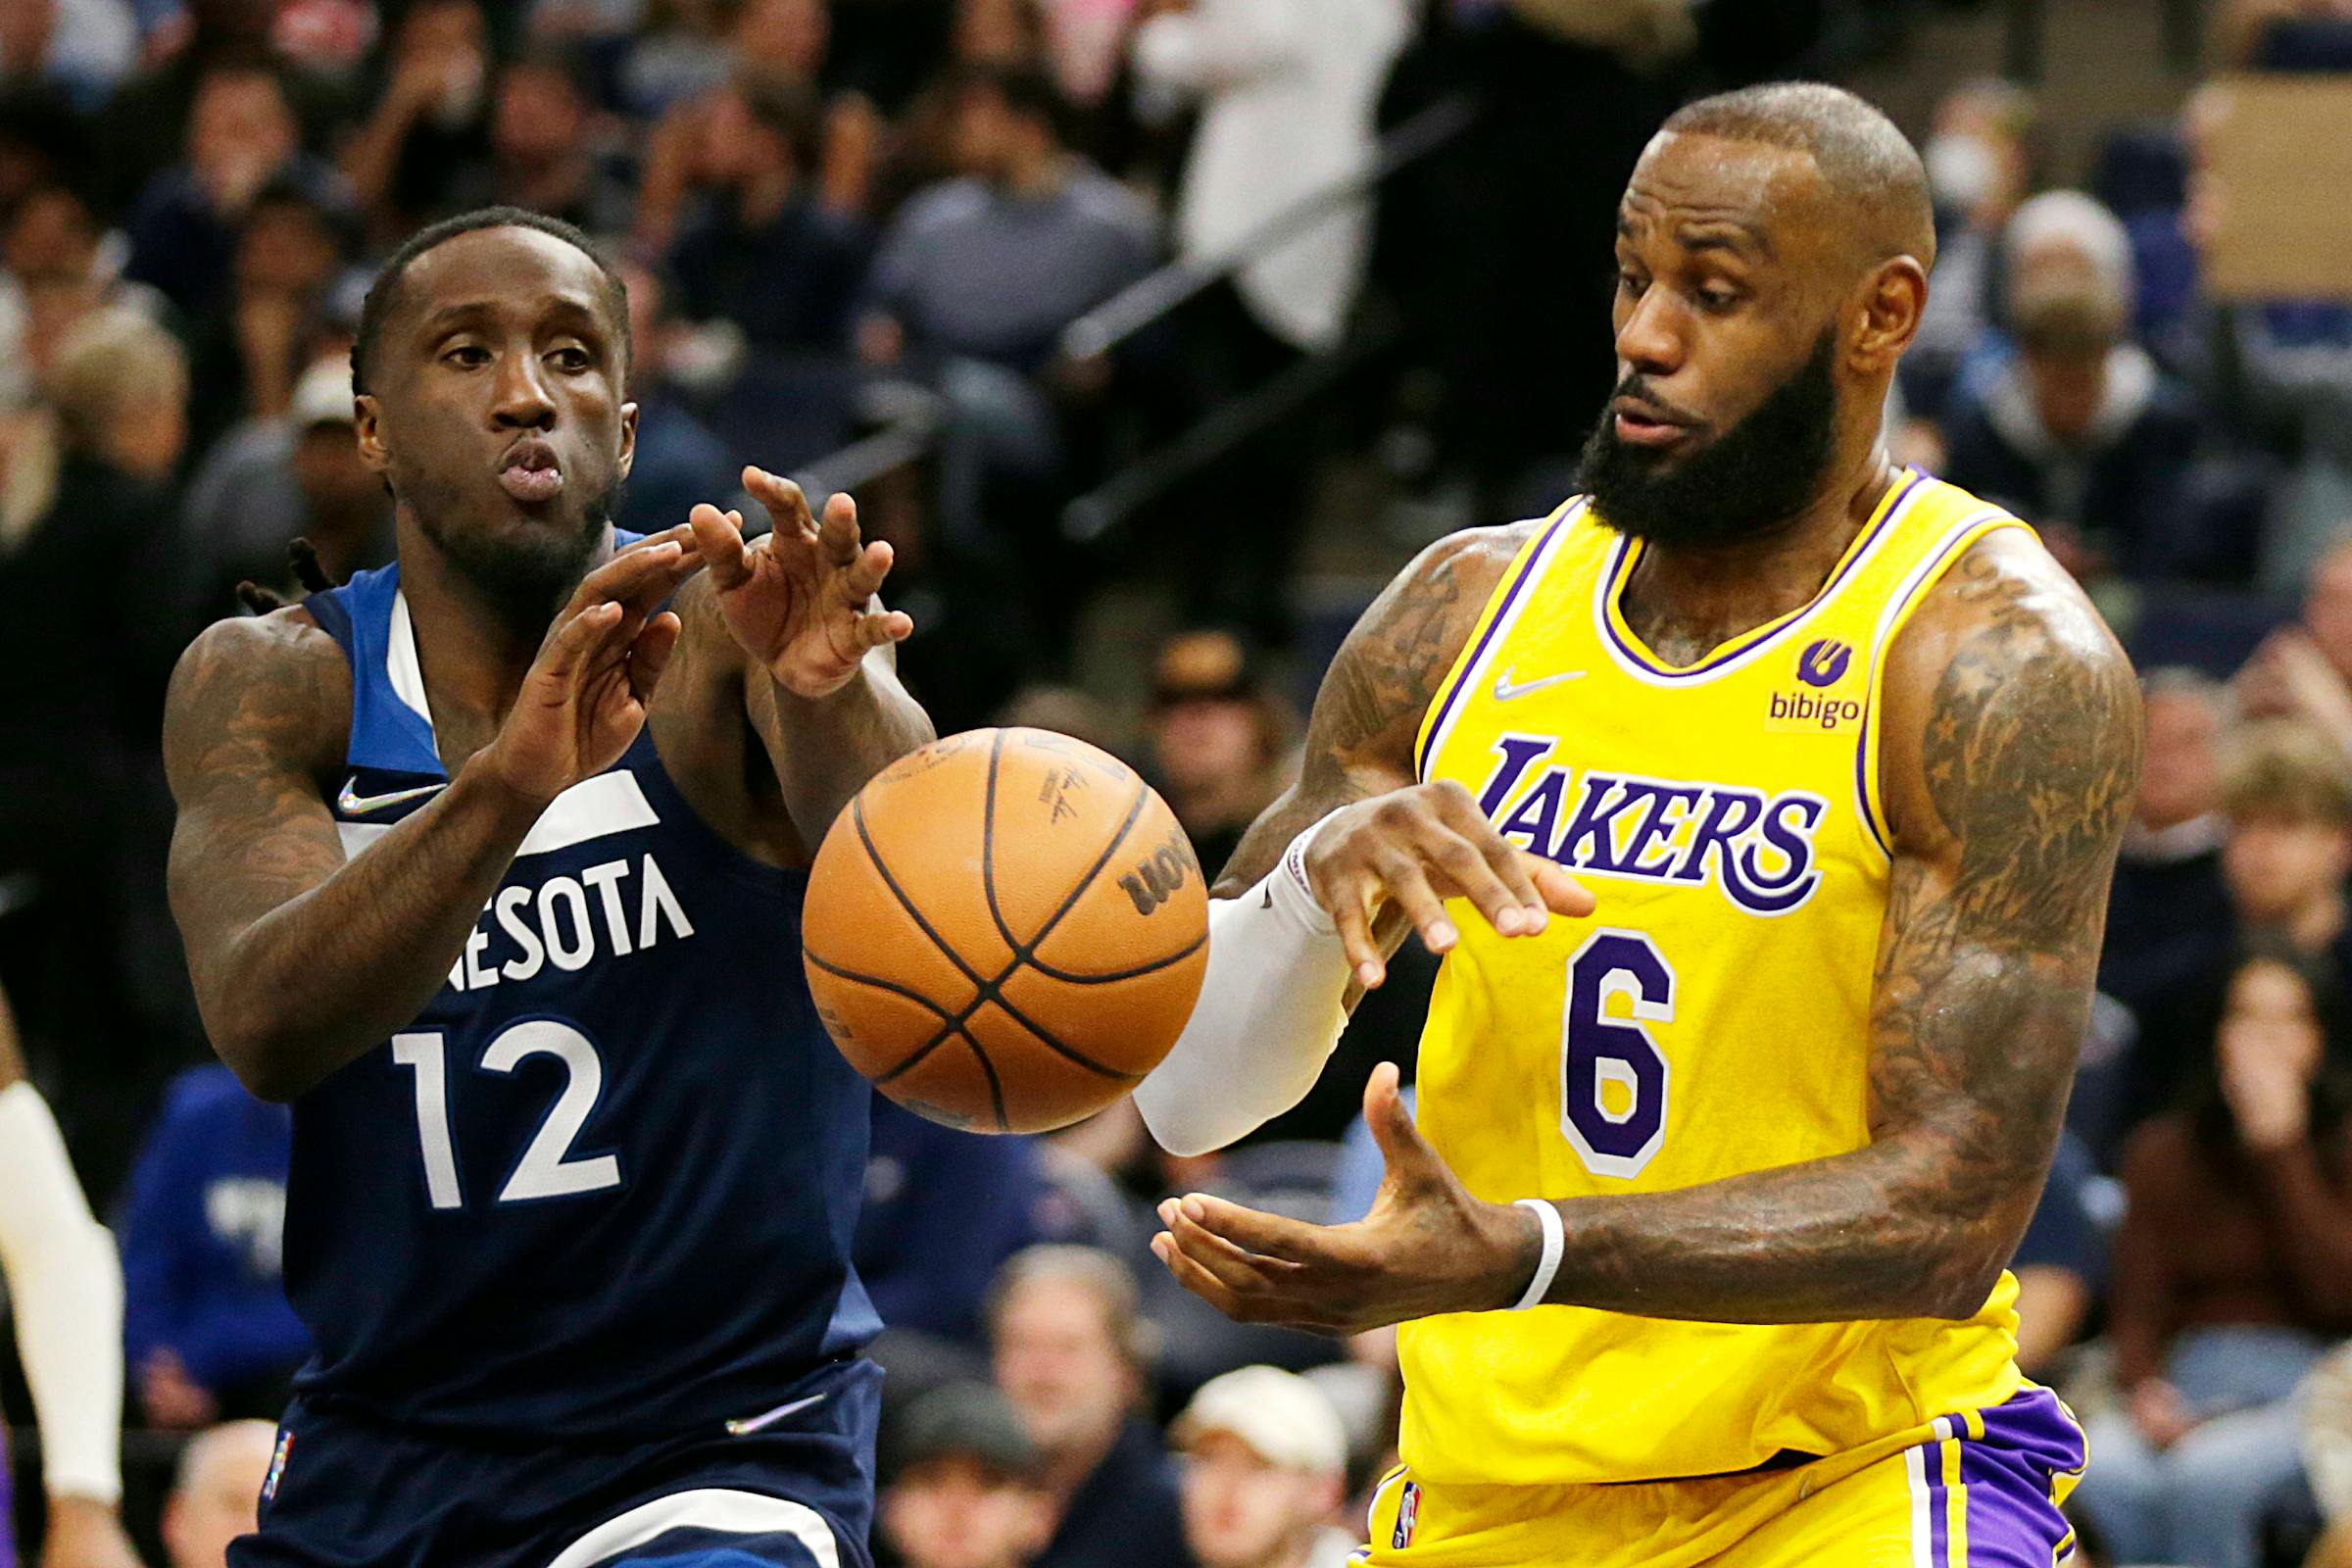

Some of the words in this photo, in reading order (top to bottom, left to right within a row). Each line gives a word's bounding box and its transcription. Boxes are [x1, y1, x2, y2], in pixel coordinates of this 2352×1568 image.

[1769, 691, 1860, 729] bibigo
[1478, 732, 1830, 917] LAKERS
[391, 1019, 621, 1209] 12
[1561, 928, 1676, 1178] 6
